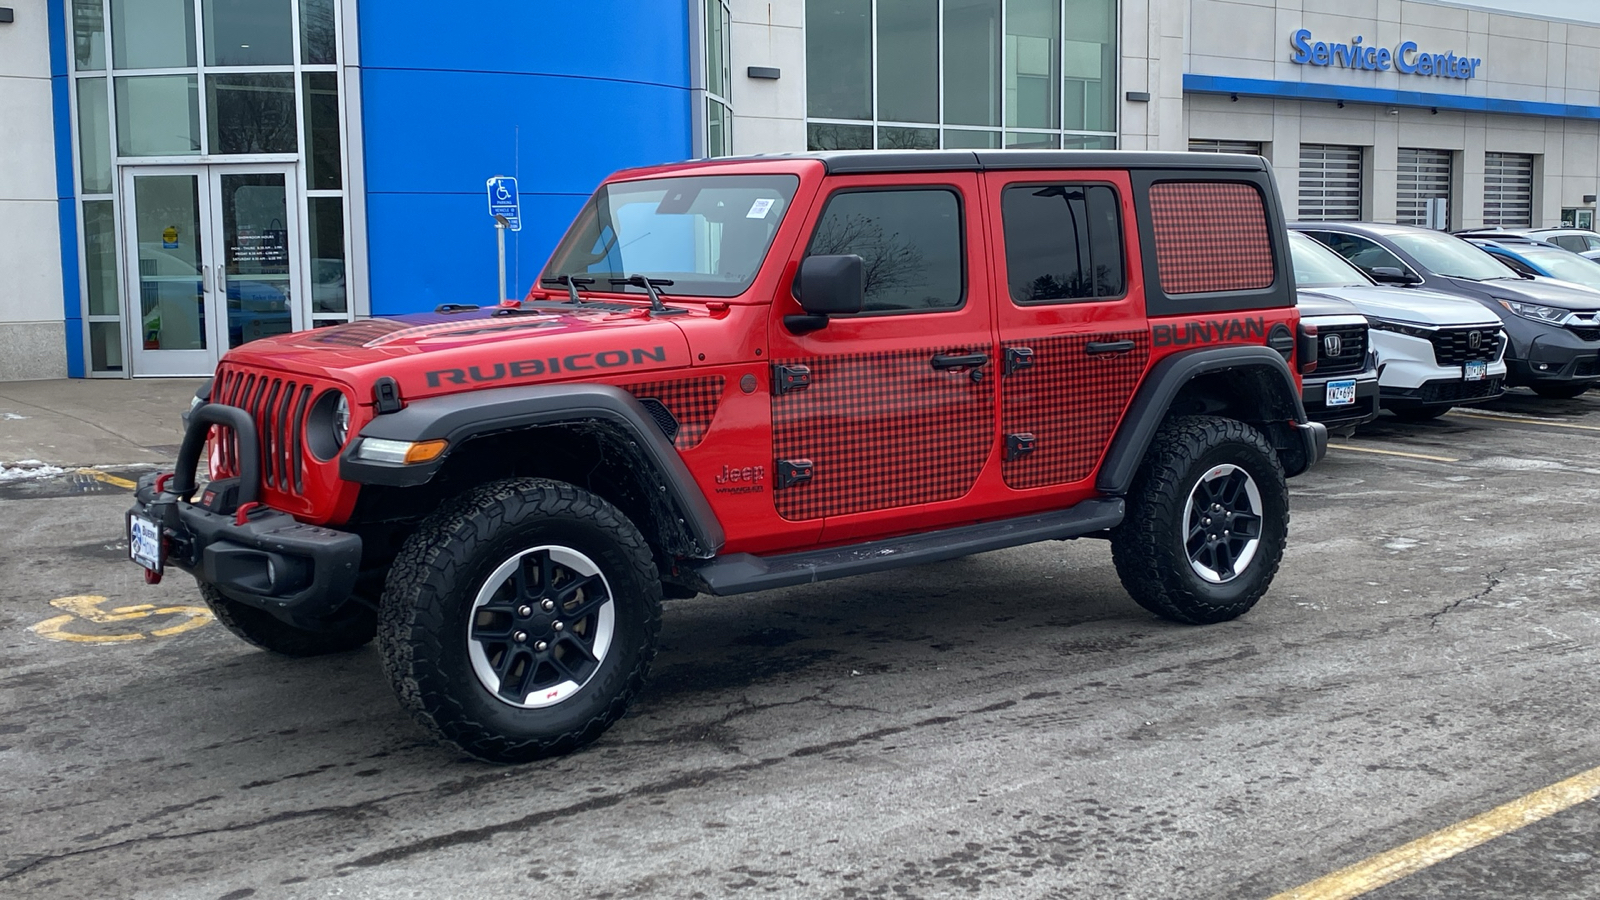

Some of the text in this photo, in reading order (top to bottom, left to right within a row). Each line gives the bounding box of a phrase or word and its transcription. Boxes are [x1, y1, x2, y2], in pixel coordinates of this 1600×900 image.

[1290, 28, 1481, 79] Service Center
[1152, 317, 1264, 347] BUNYAN
[425, 346, 666, 388] RUBICON
[715, 464, 764, 484] Jeep
